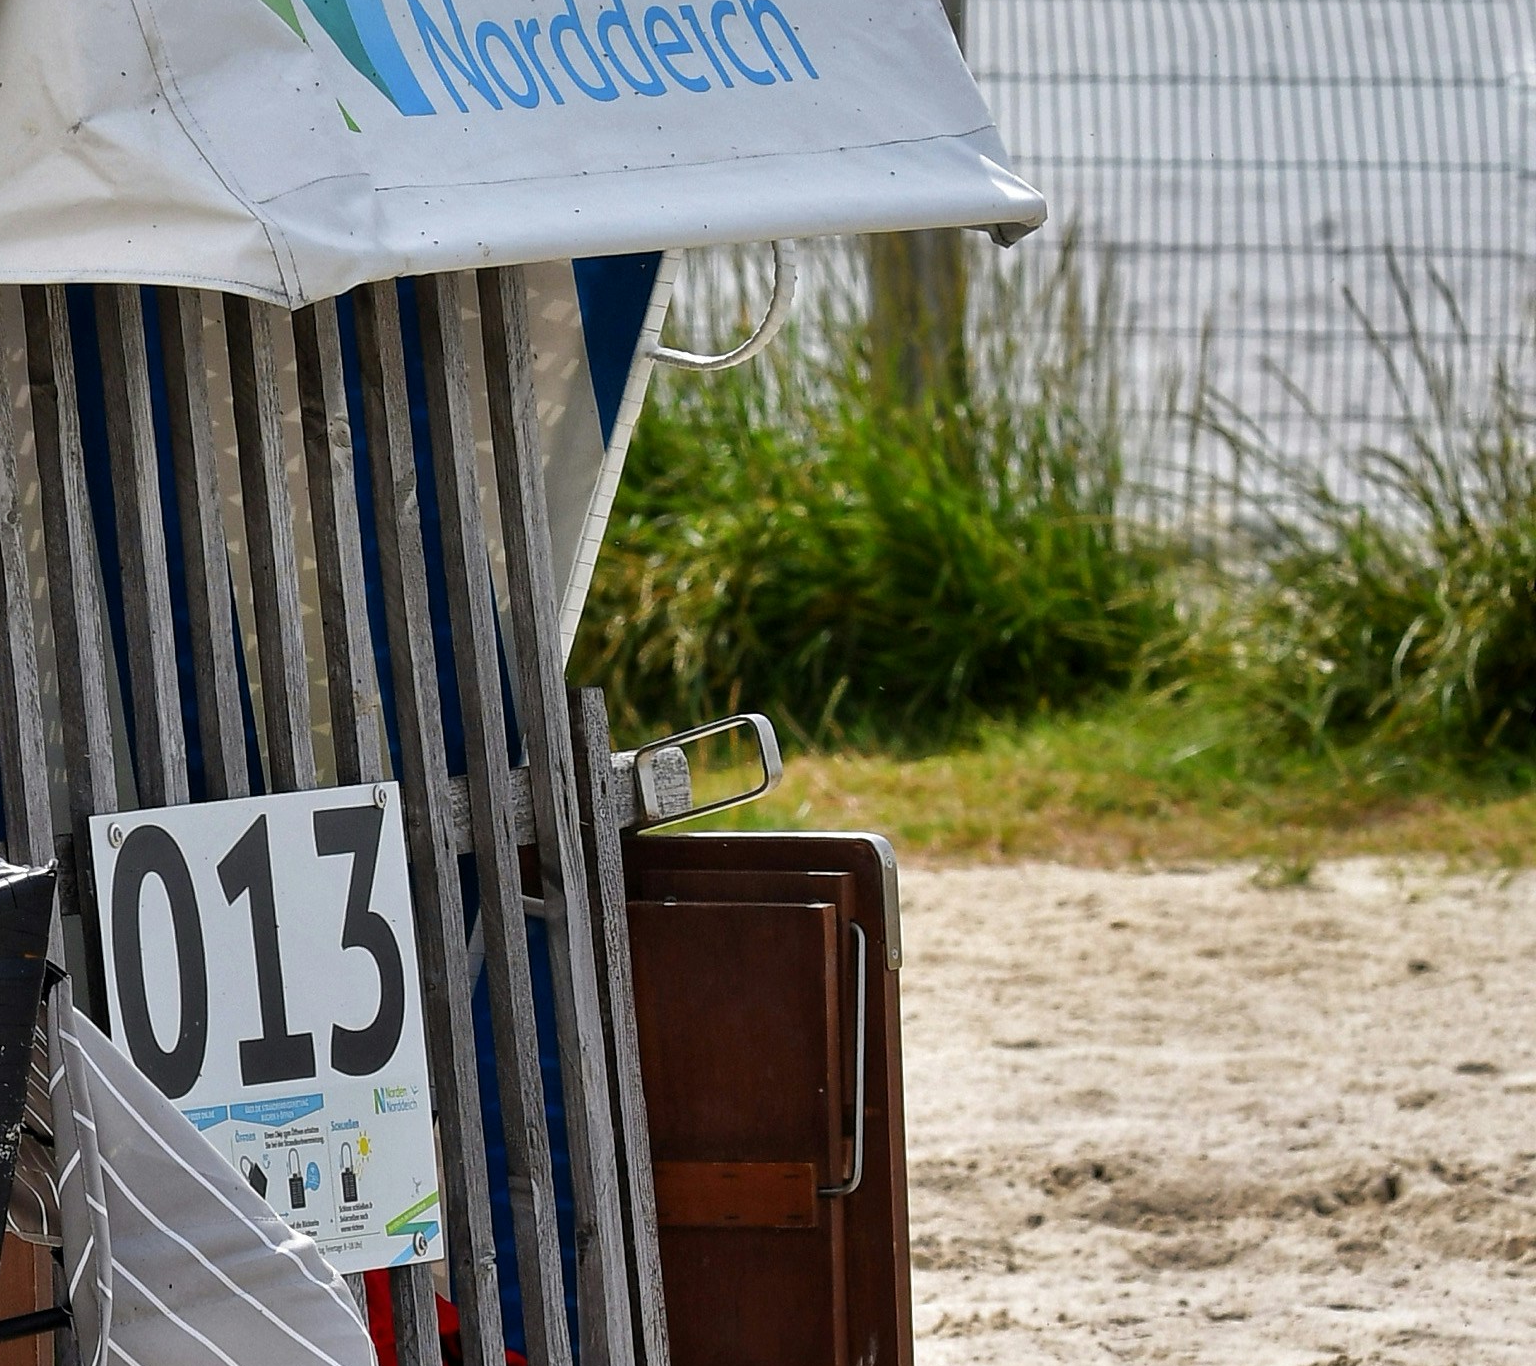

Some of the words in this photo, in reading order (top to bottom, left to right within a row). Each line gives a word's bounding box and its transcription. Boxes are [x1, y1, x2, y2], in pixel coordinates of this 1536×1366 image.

[111, 803, 406, 1100] 013
[385, 1085, 407, 1098] Norden
[386, 1097, 418, 1112] Norddeich
